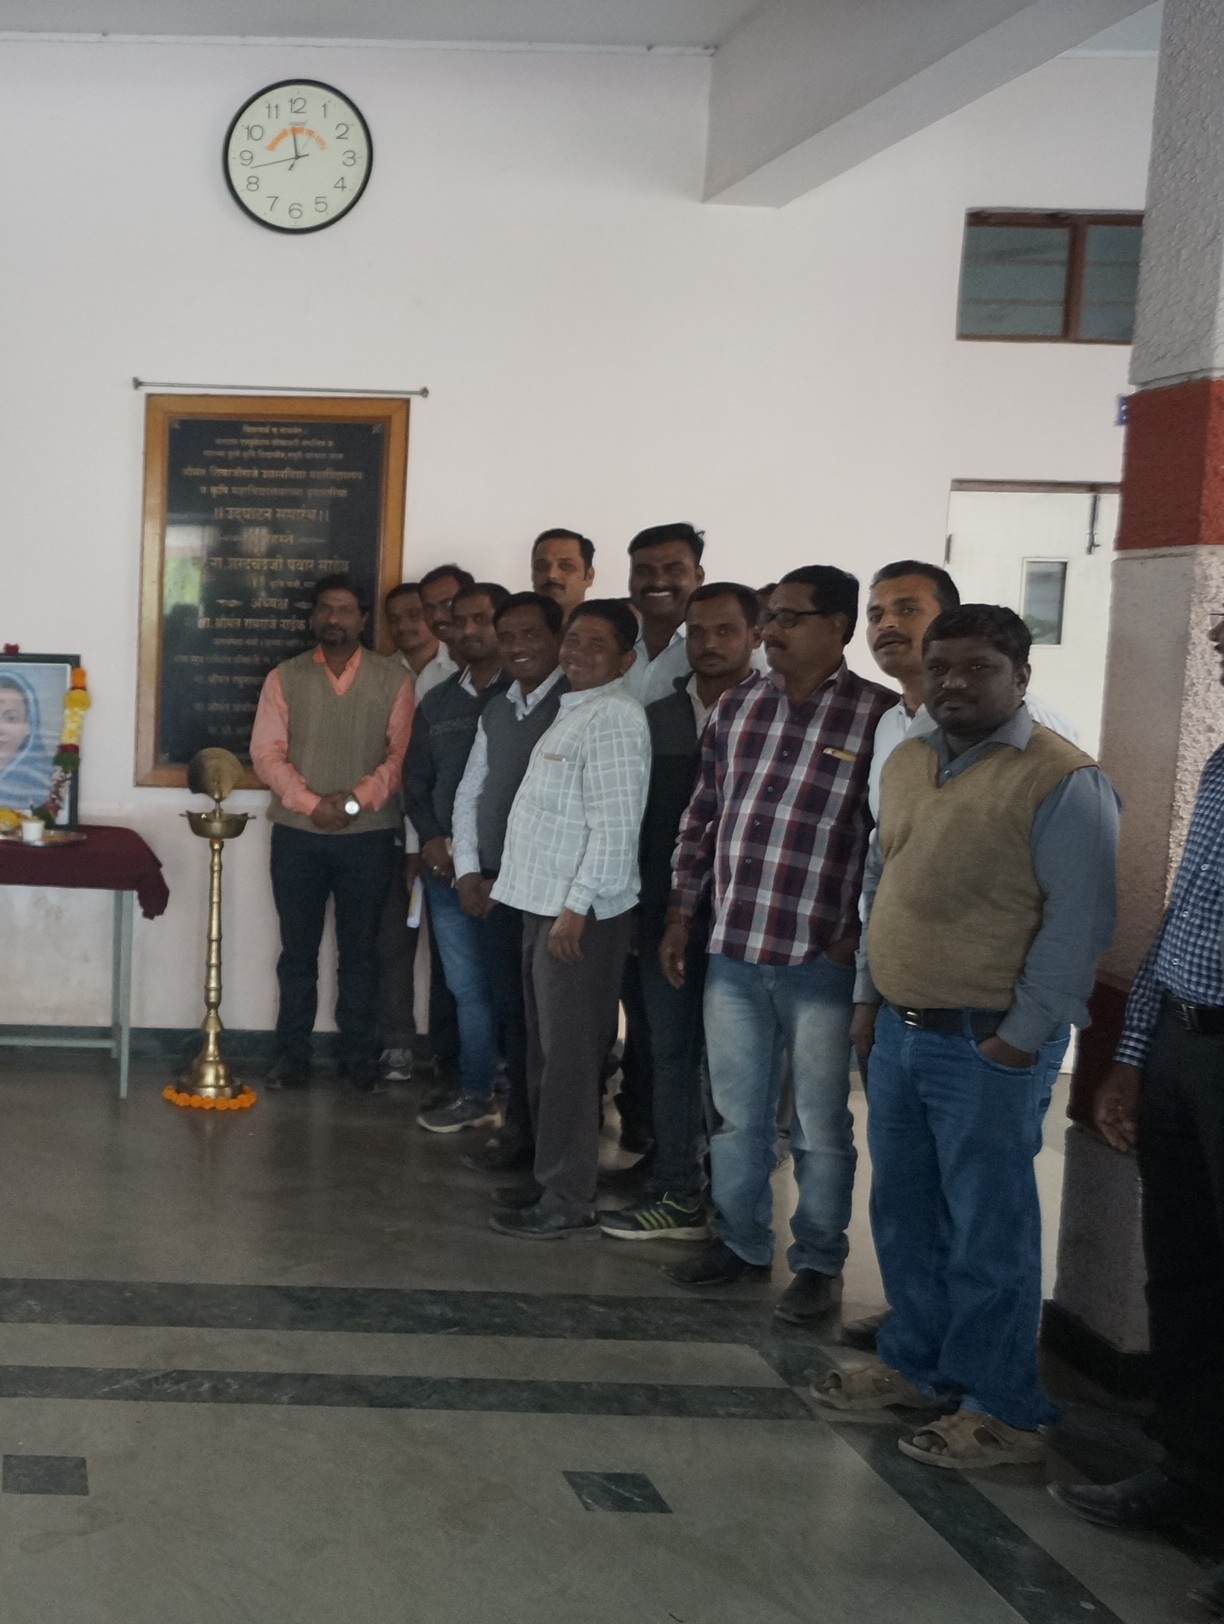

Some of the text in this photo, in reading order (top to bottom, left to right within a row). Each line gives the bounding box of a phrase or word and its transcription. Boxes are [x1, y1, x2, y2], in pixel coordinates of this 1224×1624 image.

[265, 103, 279, 119] 11
[289, 97, 307, 114] 12
[321, 103, 327, 118] 1
[245, 124, 264, 141] 10
[335, 123, 349, 140] 2
[239, 150, 253, 166] 9
[342, 150, 356, 167] 3
[246, 175, 260, 192] 8
[333, 176, 347, 192] 4
[266, 195, 279, 211] 7
[288, 203, 303, 219] 6
[314, 196, 328, 213] 5
